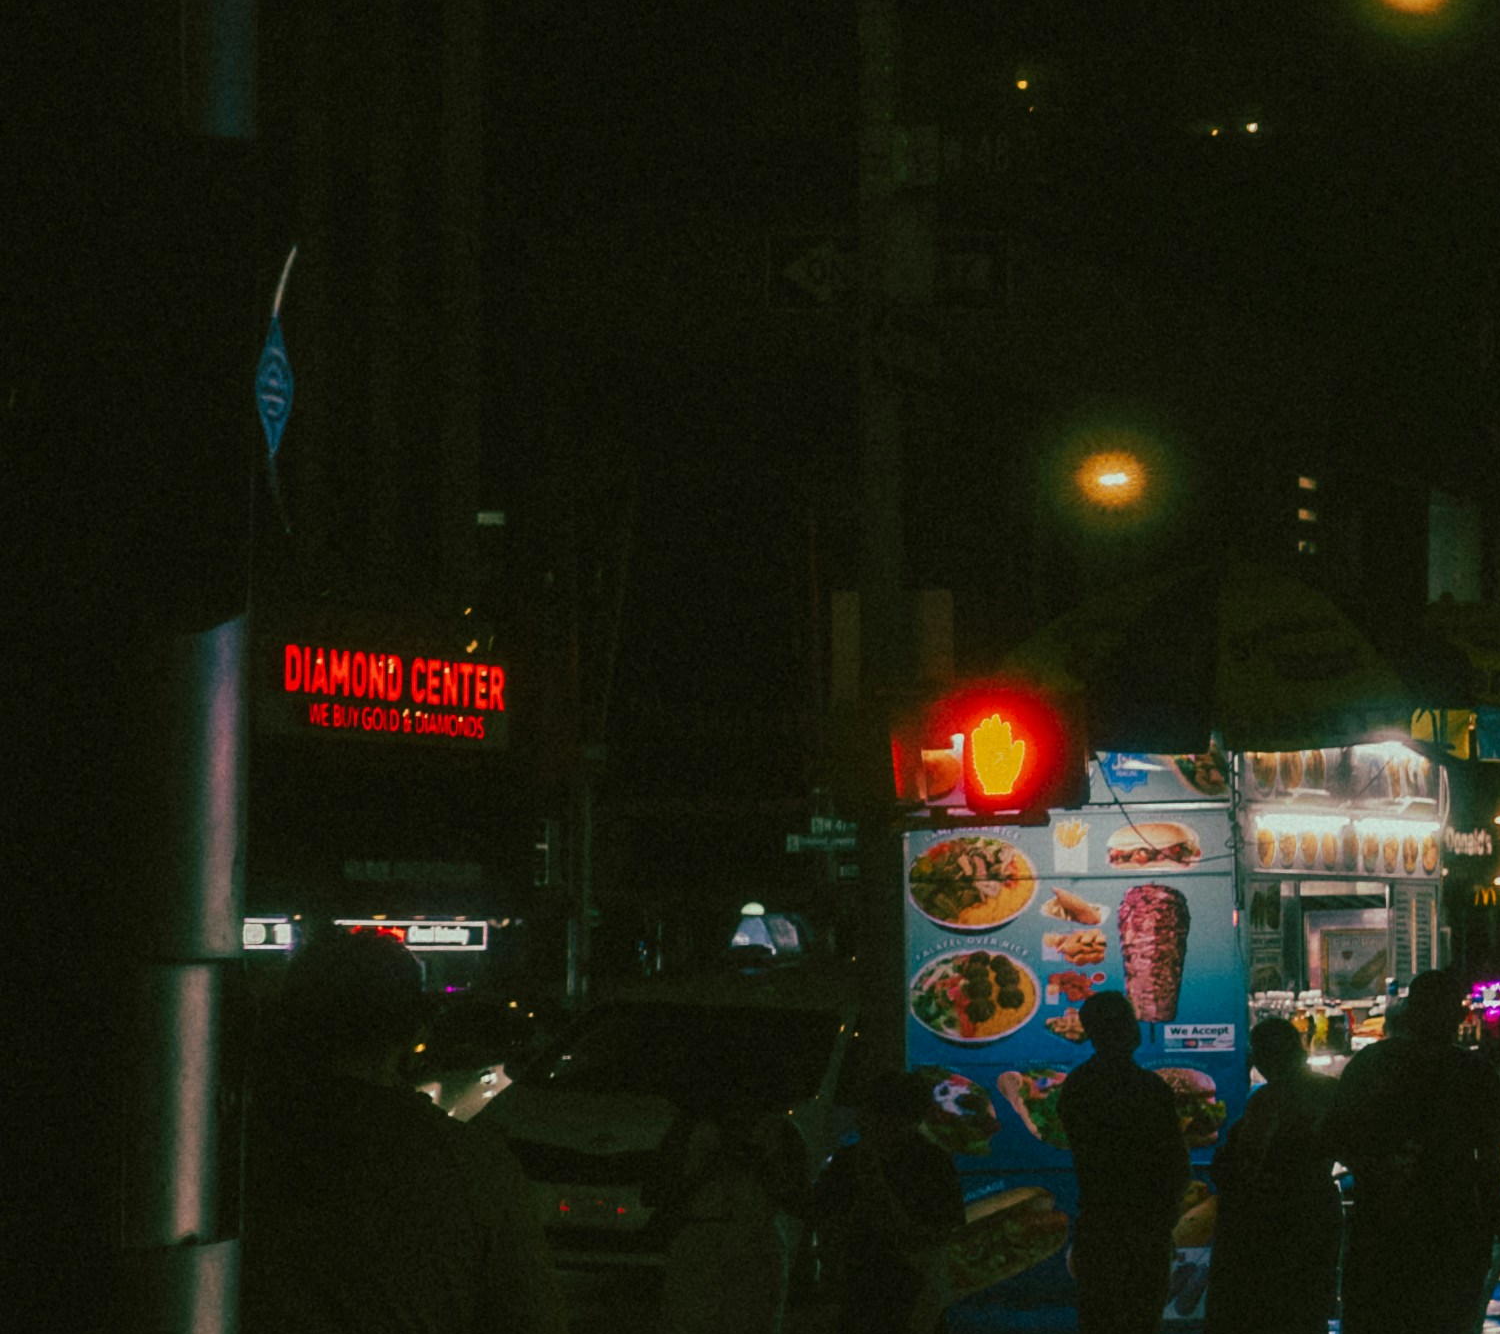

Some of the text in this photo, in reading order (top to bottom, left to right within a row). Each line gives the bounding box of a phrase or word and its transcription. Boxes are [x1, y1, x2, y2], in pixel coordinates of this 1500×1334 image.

[285, 643, 505, 712] DIAMOND CENTER
[309, 702, 329, 725] WE
[333, 703, 359, 727] BUY
[361, 707, 400, 732] GOLD
[414, 710, 485, 740] DIAMONDS
[1171, 1026, 1229, 1037] We Accept
